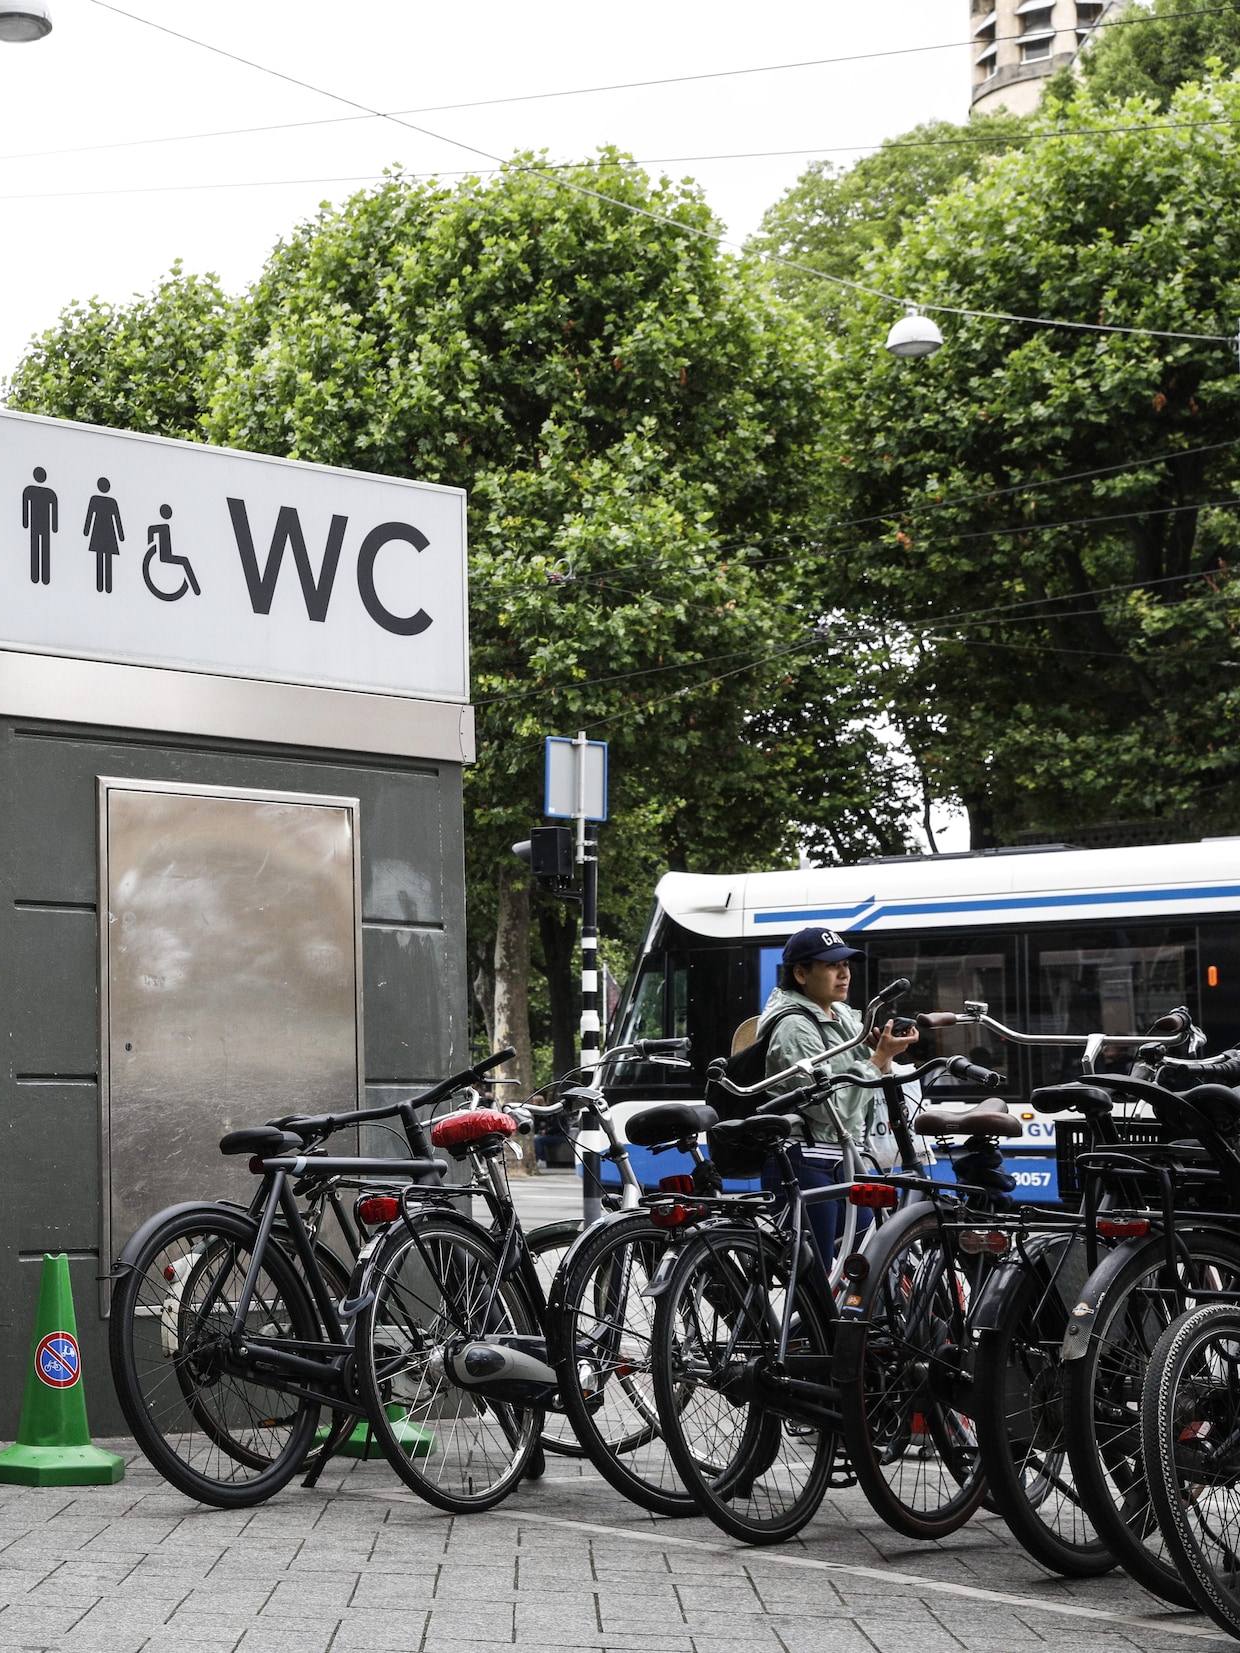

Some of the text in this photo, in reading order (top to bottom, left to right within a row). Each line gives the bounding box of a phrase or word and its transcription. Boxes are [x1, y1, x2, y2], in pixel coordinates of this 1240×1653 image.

[226, 496, 434, 636] WC
[821, 931, 845, 946] GA
[1027, 1123, 1055, 1137] GV
[1011, 1171, 1051, 1187] 3057
